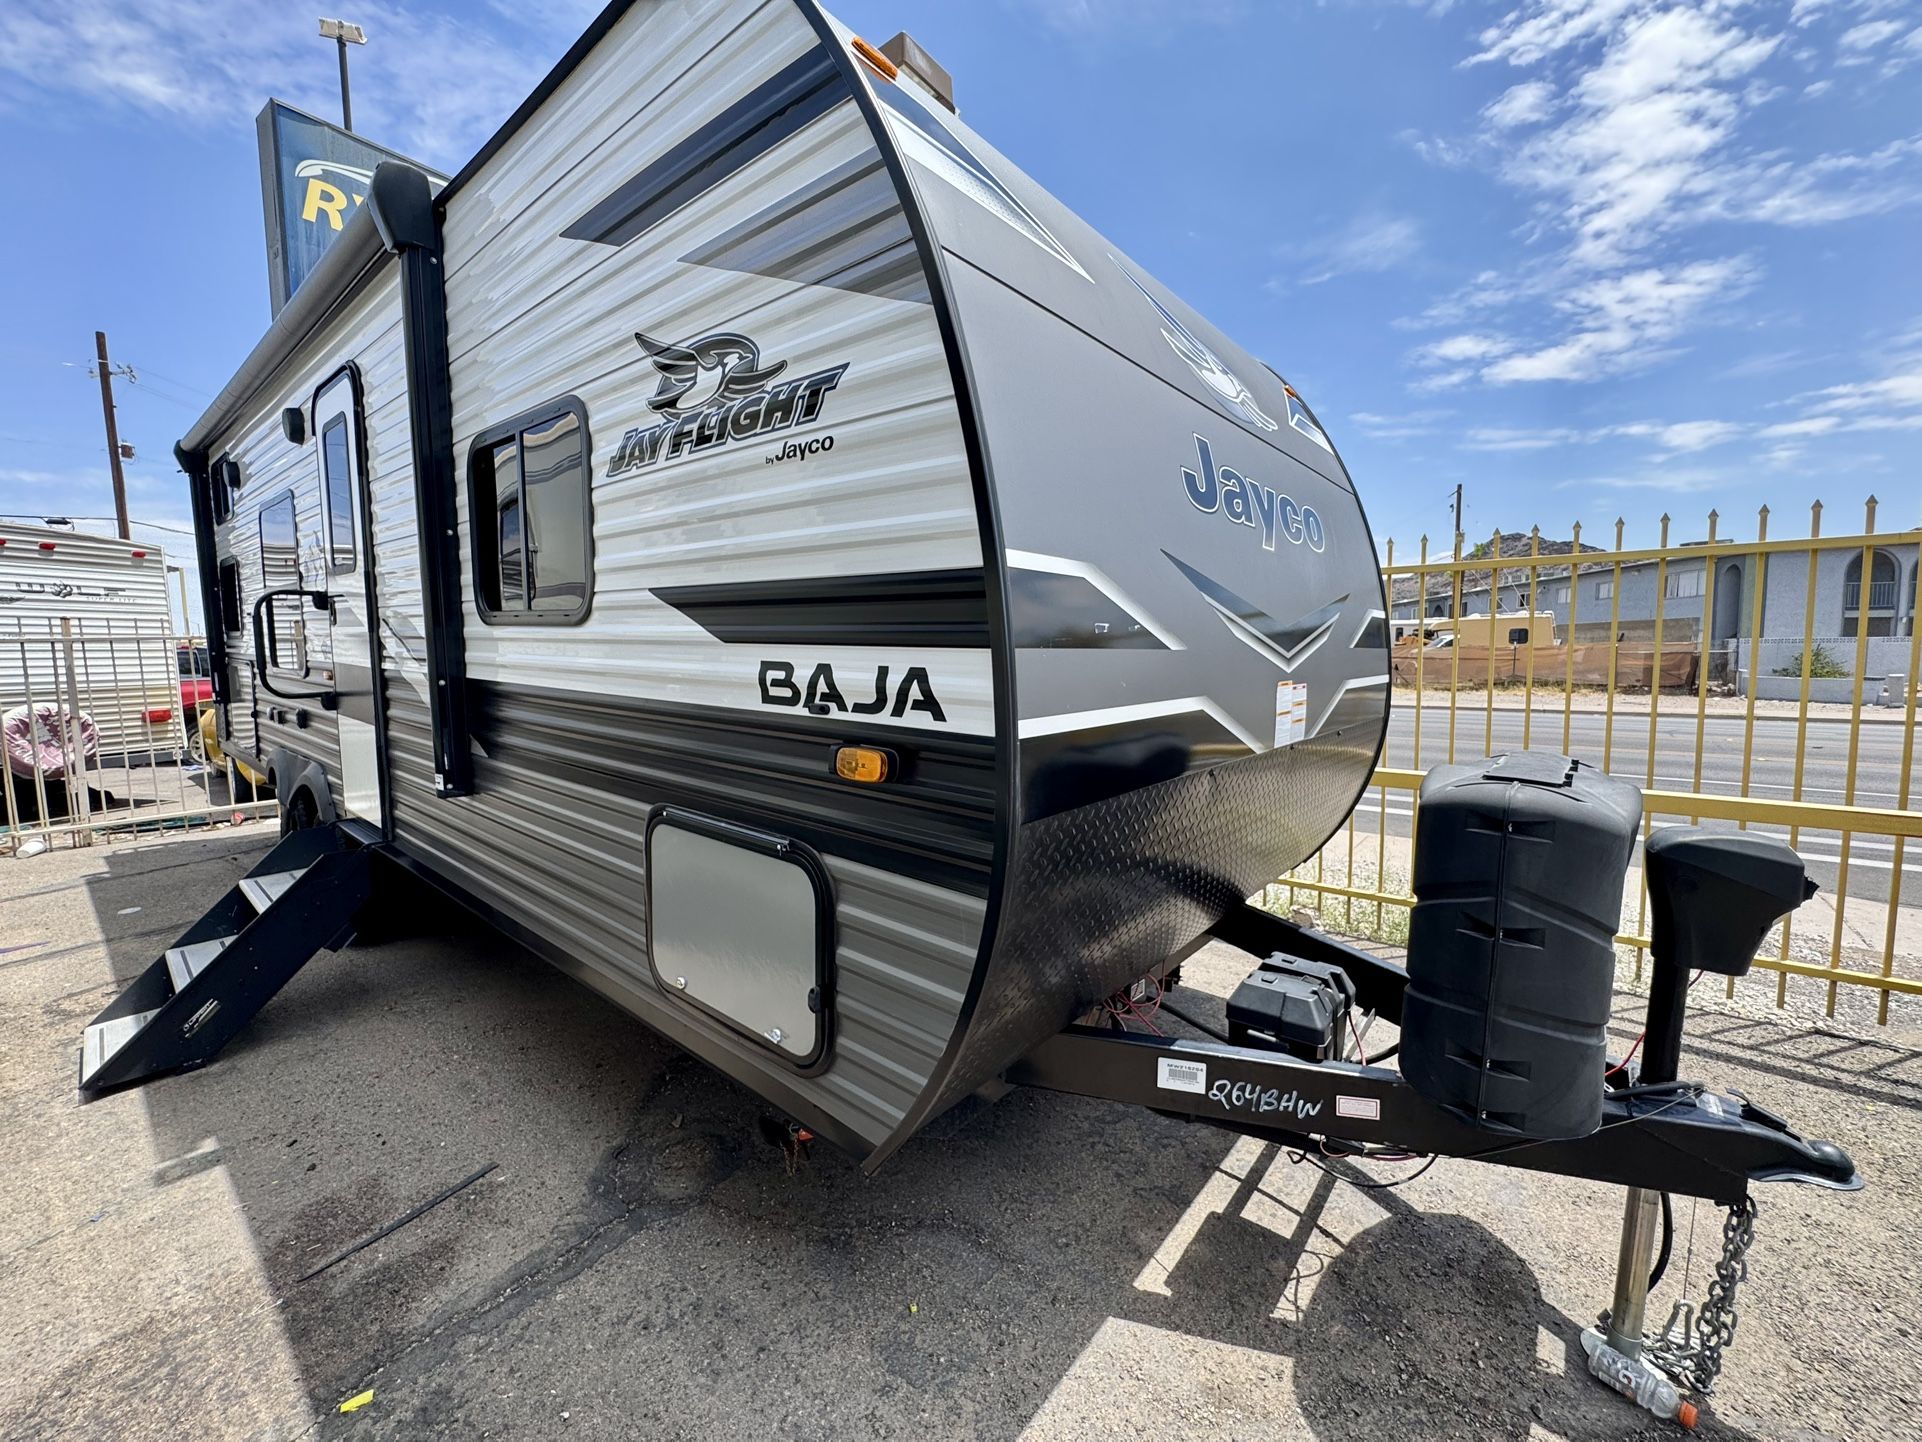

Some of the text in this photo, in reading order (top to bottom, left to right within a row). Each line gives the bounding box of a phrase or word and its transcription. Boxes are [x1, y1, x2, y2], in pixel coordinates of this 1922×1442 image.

[302, 177, 365, 231] R
[606, 362, 850, 477] JAY FLIGHT
[765, 435, 834, 465] by Jayco
[1180, 431, 1325, 553] Jayco
[758, 660, 947, 722] BAJA
